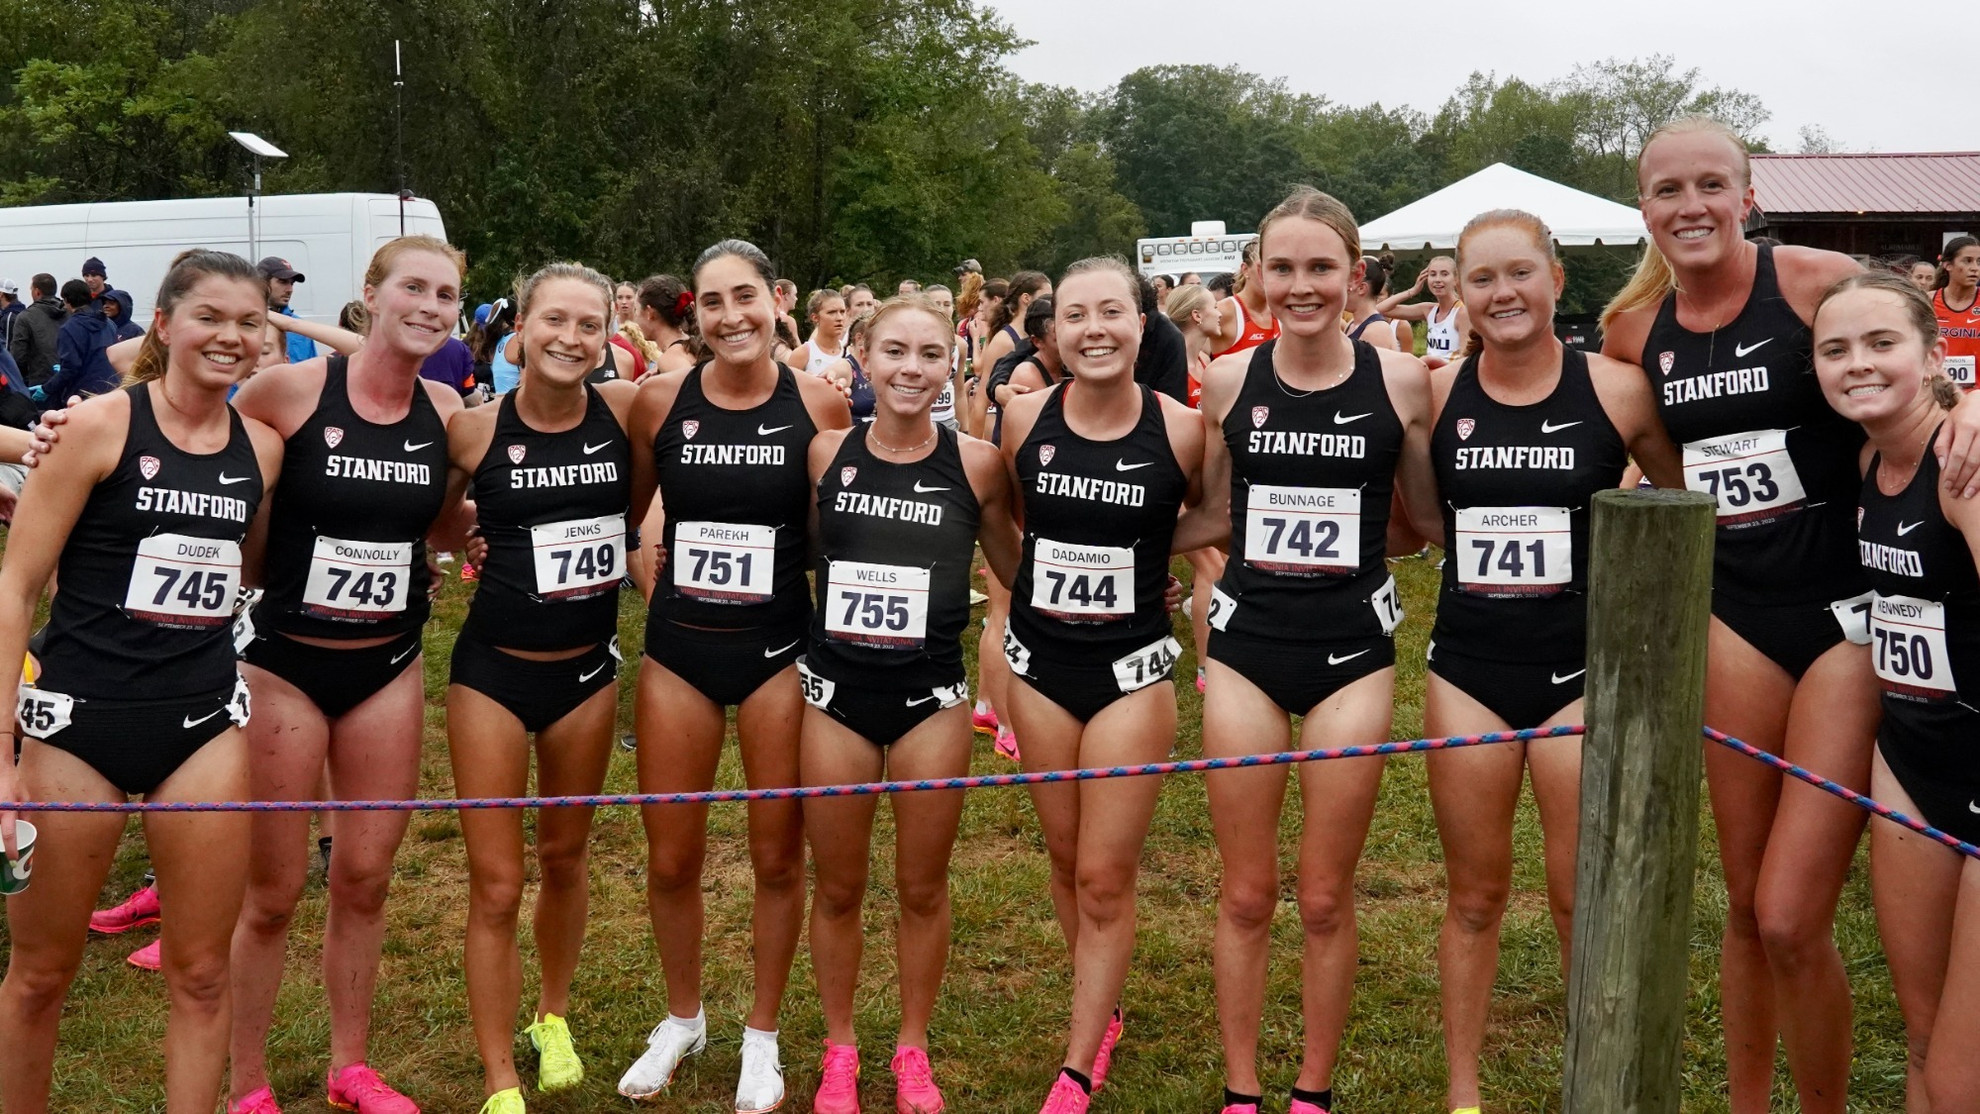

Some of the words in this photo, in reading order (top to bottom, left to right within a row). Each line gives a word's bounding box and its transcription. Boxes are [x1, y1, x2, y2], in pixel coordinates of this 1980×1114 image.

[1663, 366, 1770, 406] STANFORD
[680, 443, 785, 466] STANFORD
[1247, 431, 1366, 459] STANFORD
[1455, 446, 1575, 471] STANFORD
[1701, 437, 1760, 457] STEWART
[325, 455, 431, 486] STANFORD
[510, 461, 618, 489] STANFORD
[1698, 462, 1780, 509] 753
[135, 486, 247, 523] STANFORD
[1035, 471, 1146, 508] STANFORD
[1269, 493, 1336, 508] BUNNAGE
[834, 491, 943, 526] STANFORD
[1481, 514, 1538, 527] ARCHER
[564, 523, 602, 539] JENKS
[699, 527, 750, 542] PAREKH
[1262, 517, 1340, 559] 742
[177, 543, 221, 559] DUDEK
[335, 545, 400, 560] CONNOLLY
[550, 543, 615, 585] 749
[1052, 548, 1111, 564] DADAMIO
[1253, 561, 1289, 572] VIRGINIA
[1471, 539, 1546, 578] 741
[1859, 539, 1924, 578] TANFORD
[688, 548, 752, 587] 751
[856, 569, 897, 583] WELLS
[152, 566, 229, 610] 745
[326, 567, 397, 606] 743
[1046, 570, 1118, 608] 744
[1465, 583, 1501, 593] VIRGINIA
[1503, 584, 1560, 593] INVITATIONAL
[841, 591, 909, 632] 755
[1877, 599, 1923, 619] KENNEDY
[1126, 643, 1176, 684] 744
[1875, 627, 1934, 680] 750
